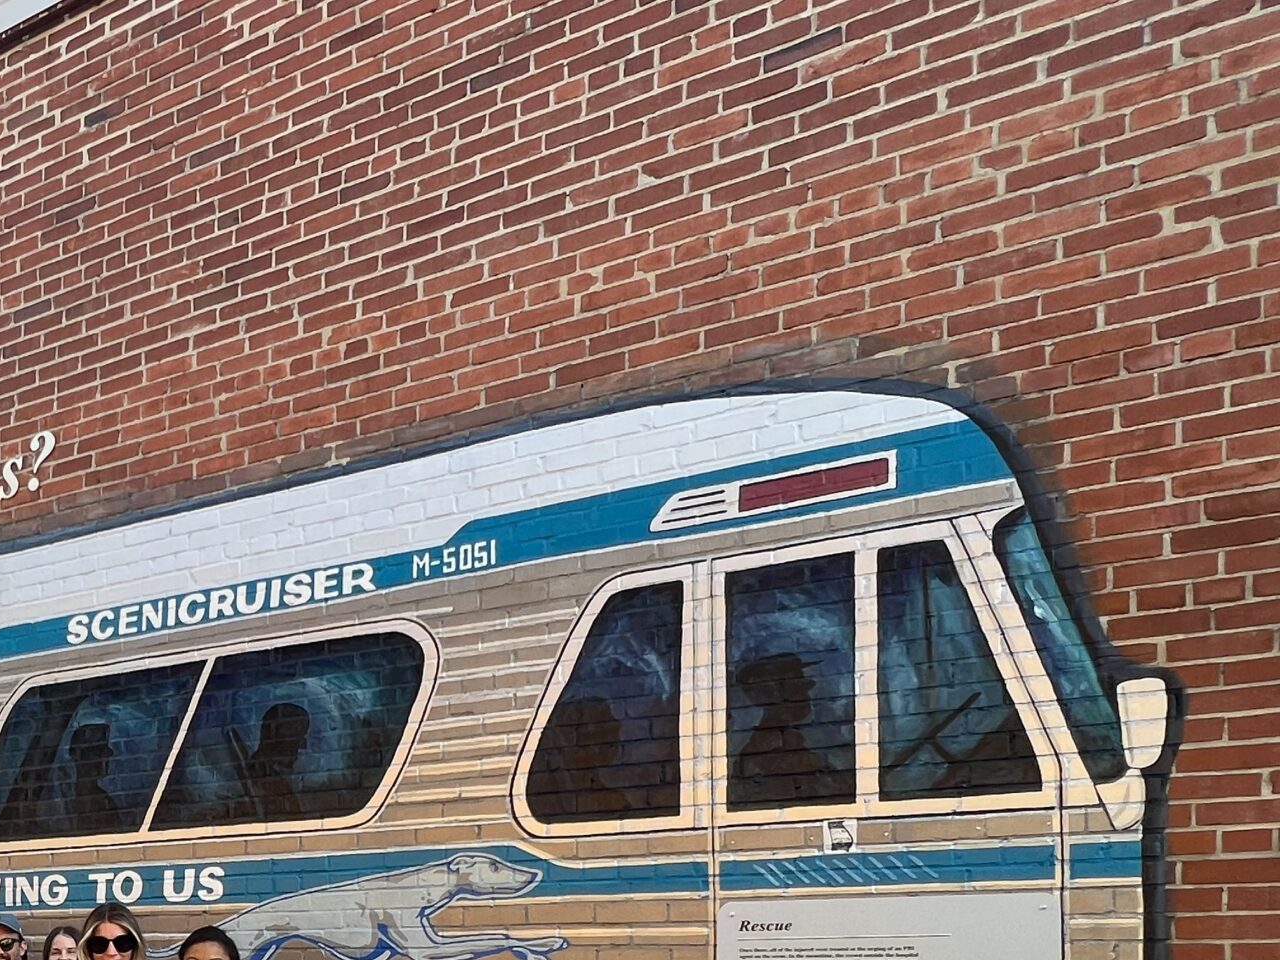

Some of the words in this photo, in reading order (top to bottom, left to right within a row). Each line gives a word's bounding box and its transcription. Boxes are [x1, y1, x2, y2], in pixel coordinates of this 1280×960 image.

[66, 562, 377, 645] SCENICRUISER
[411, 538, 497, 580] M-5051
[88, 869, 143, 904] TO
[163, 866, 225, 903] US
[738, 919, 793, 933] Rescue
